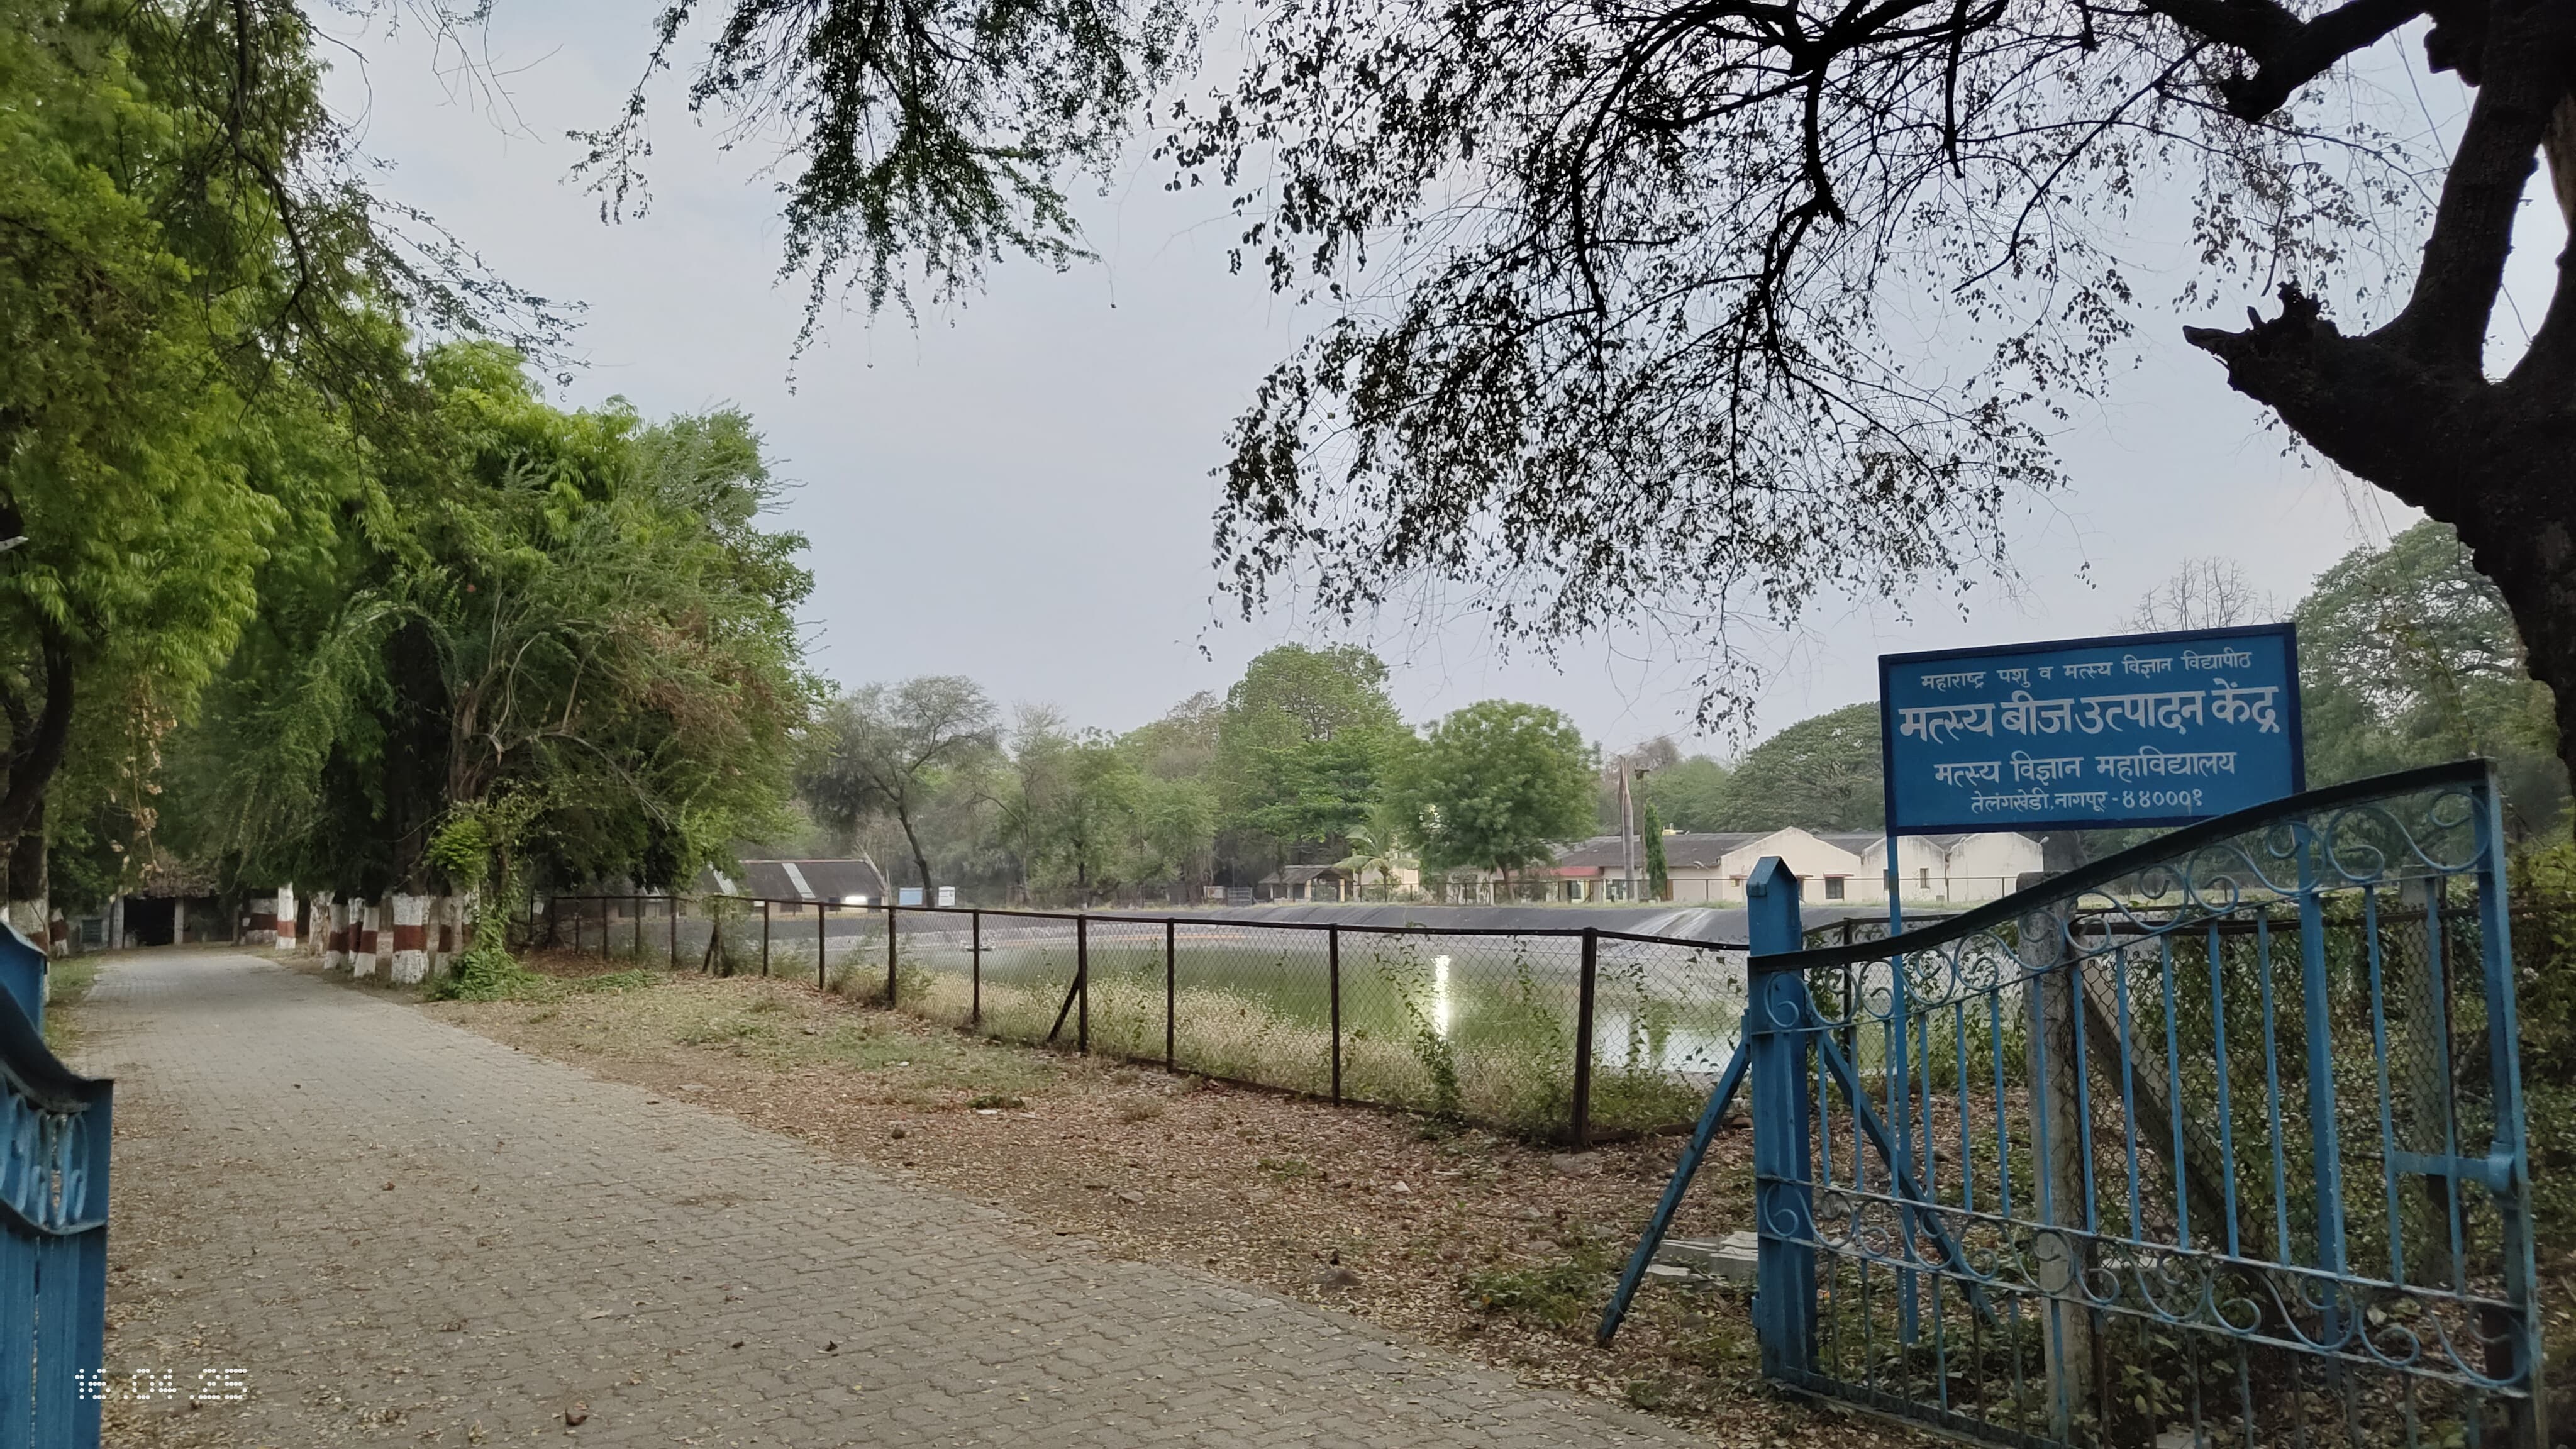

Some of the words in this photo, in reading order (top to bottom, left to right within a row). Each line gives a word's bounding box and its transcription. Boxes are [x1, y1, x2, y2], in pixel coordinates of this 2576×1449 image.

[1920, 671, 1987, 692] महाराष्ट्र
[1996, 667, 2031, 688] पशु
[2038, 666, 2054, 680] व
[2062, 662, 2113, 679] मत्स्य
[2121, 654, 2174, 679] विज्ञान
[2180, 647, 2252, 670] विद्यापीठ
[1898, 702, 1995, 745] मत्स्य
[2001, 689, 2074, 736] बीज
[2075, 690, 2206, 735] उत्पादन
[2211, 677, 2280, 734] केंद्र
[1933, 760, 2001, 789] मत्स्य
[2009, 750, 2084, 786] विज्ञान
[2095, 745, 2237, 783] महाविद्यालय
